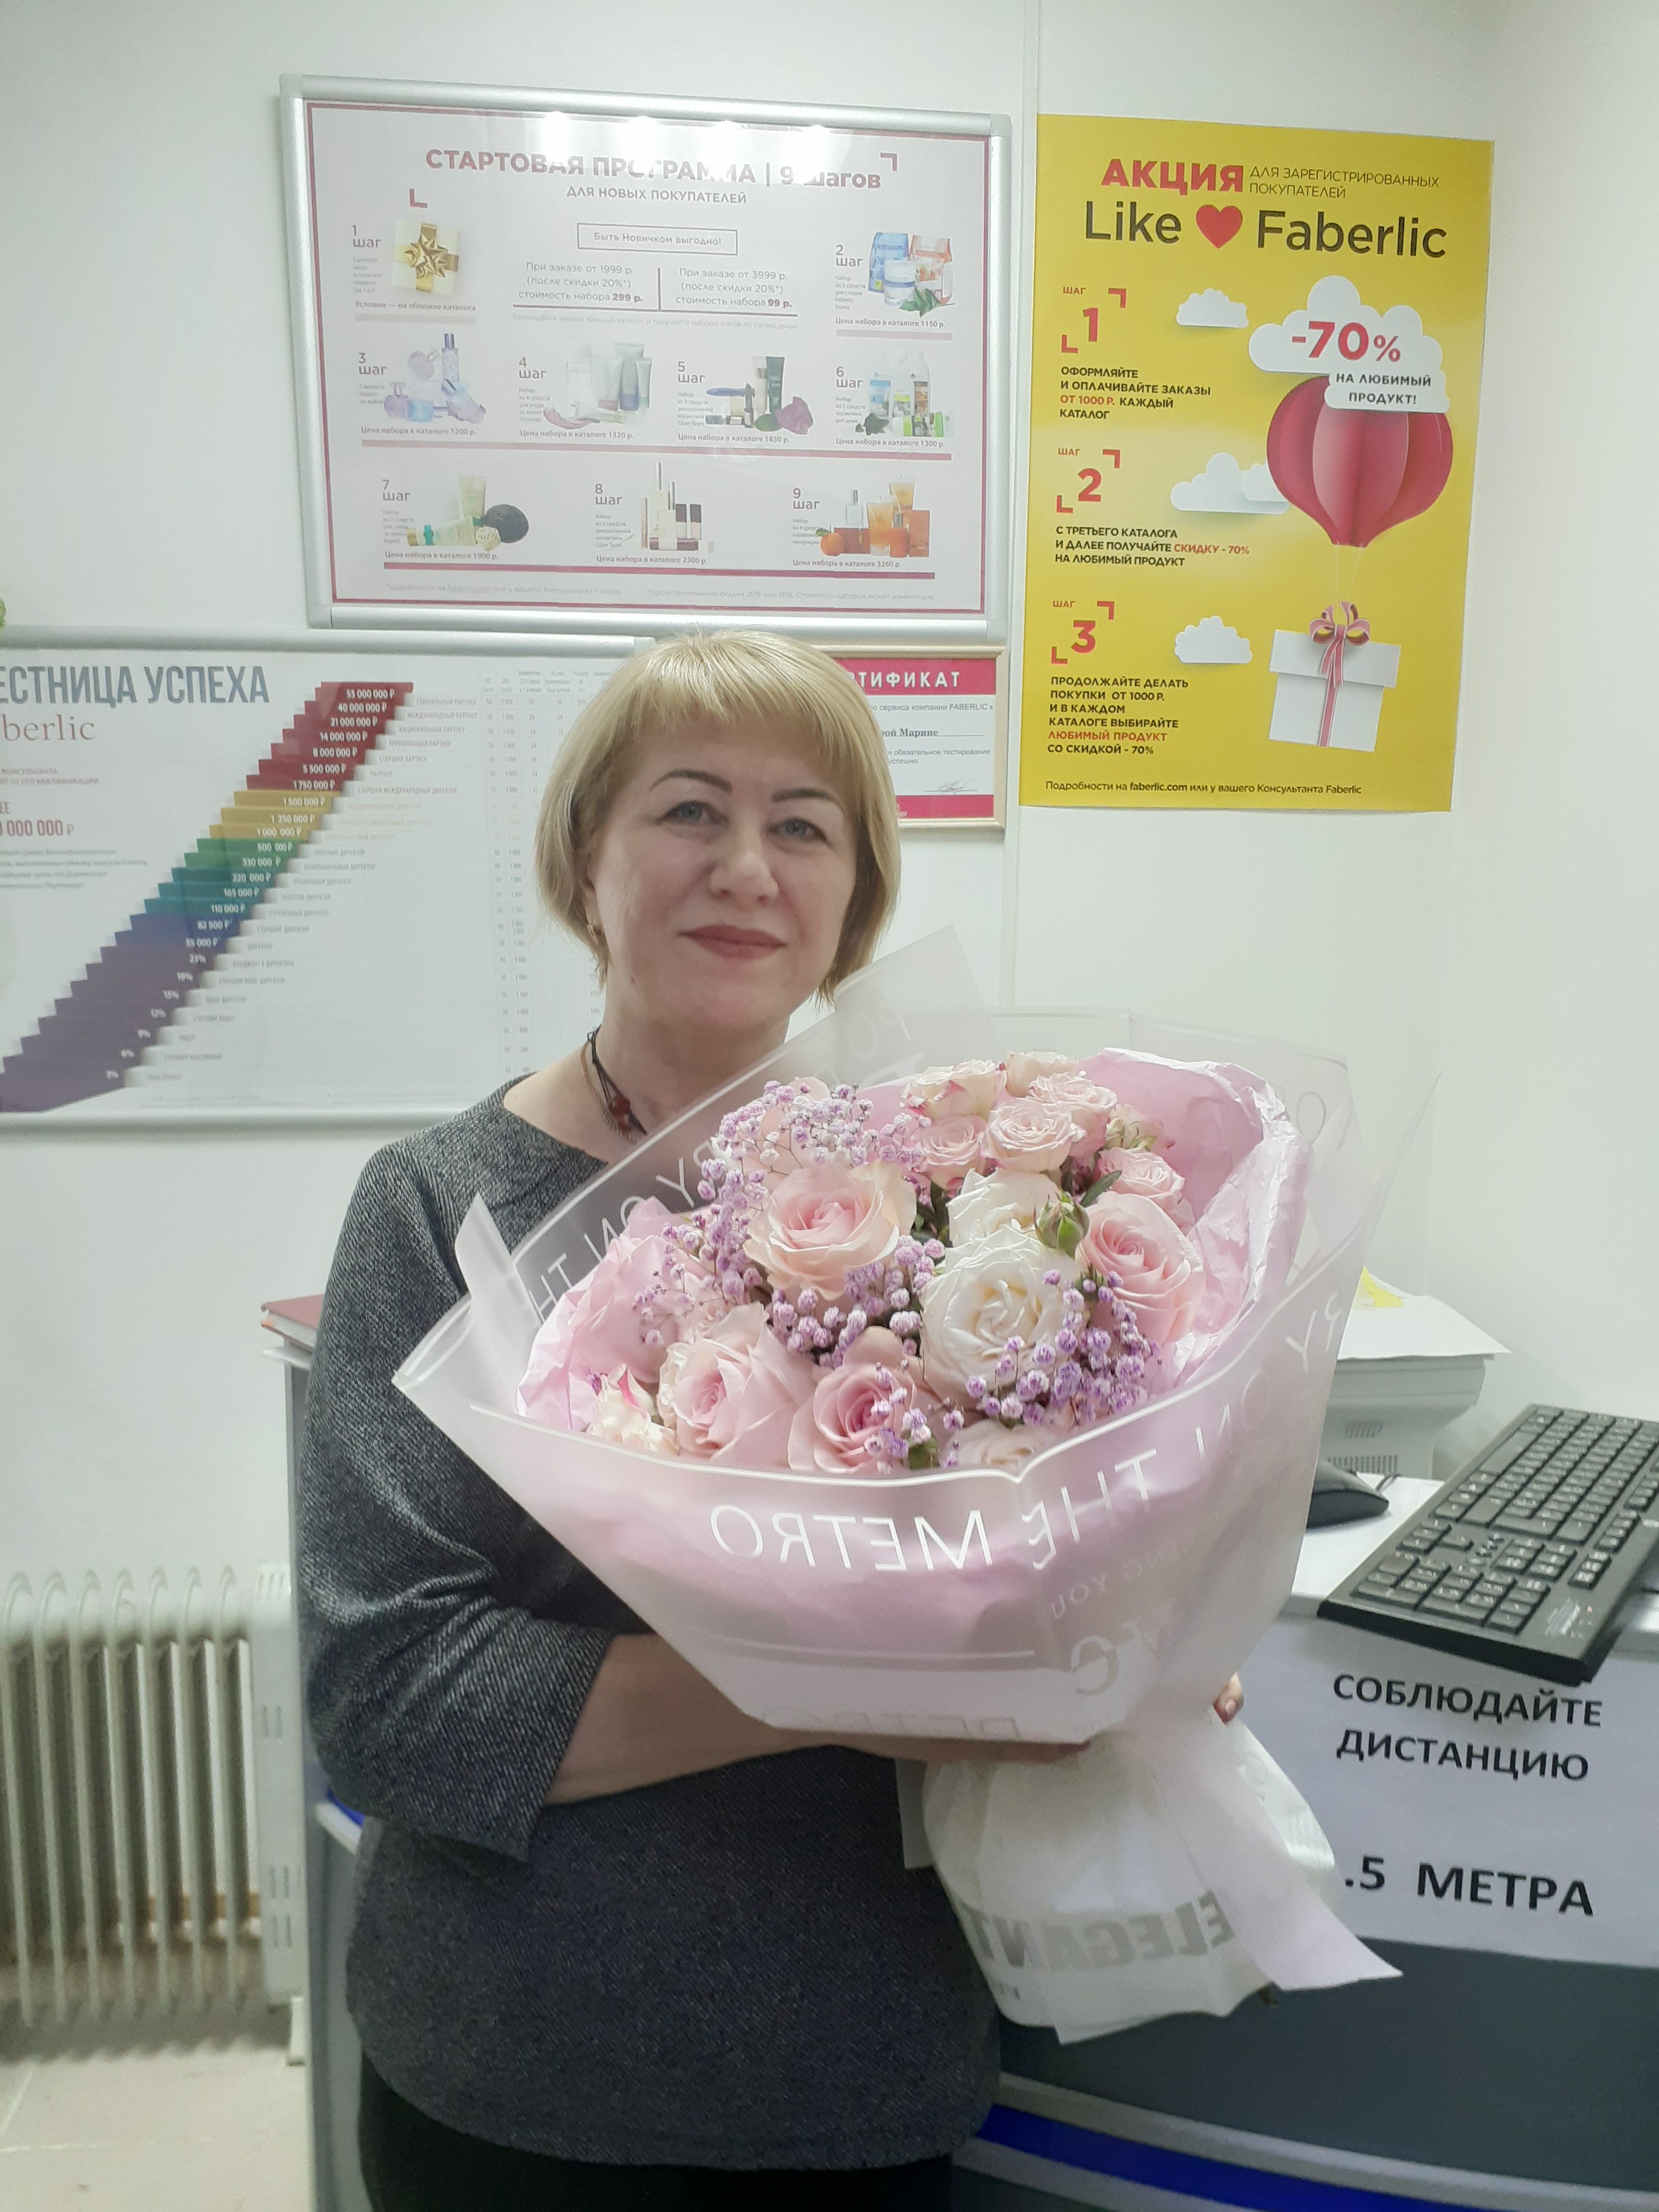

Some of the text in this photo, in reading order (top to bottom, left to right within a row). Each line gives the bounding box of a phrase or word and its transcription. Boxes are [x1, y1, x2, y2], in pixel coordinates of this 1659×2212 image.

[426, 149, 584, 176] СТАРТОВАЯ
[1100, 157, 1245, 195] АКЦИЯ
[1250, 166, 1439, 188] ДЛЯ ЗАРЕГИСТРИРОВАННЫХ
[567, 186, 747, 204] ДЛЯ НОВЫХ ПОКУПАТЕЛЕЙ
[1250, 183, 1345, 199] ПОКУПАТЕЛЕЙ
[352, 225, 357, 236] 1
[1086, 201, 1446, 258] Like Faberlic
[353, 238, 382, 248] шаг
[594, 231, 722, 245] Быть Новичком выгодно!
[836, 245, 843, 256] 2
[526, 261, 547, 272] При
[549, 264, 583, 273] заказе
[585, 266, 597, 274] от
[599, 263, 624, 275] 1999
[836, 257, 863, 267] шаг
[679, 267, 700, 278] При
[702, 270, 736, 279] заказе
[752, 269, 777, 280] 3999
[527, 275, 561, 286] (после
[564, 279, 601, 287] скидки
[681, 281, 714, 292] (после
[717, 284, 753, 293] скидки
[1063, 286, 1086, 295] ШАГ
[518, 291, 571, 300] стоимость
[573, 292, 611, 303] набора
[612, 293, 631, 302] 299
[675, 296, 728, 305] стоимость
[730, 297, 767, 307] набора
[767, 298, 780, 307] 99
[835, 317, 854, 326] Цена
[855, 317, 881, 326] набора
[921, 320, 938, 328] 1150
[1082, 306, 1100, 343] 1
[1292, 320, 1400, 362] -70%
[359, 353, 365, 364] 3
[519, 356, 527, 368] 4
[359, 365, 387, 375] шаг
[678, 361, 685, 372] 5
[836, 366, 844, 377] 6
[1062, 367, 1138, 378] ОФОРМЛЯЙТЕ
[519, 370, 547, 379] шаг
[678, 373, 705, 384] шаг
[1336, 373, 1431, 386] НА ЛЮБИМЫЙ
[837, 378, 863, 388] шаг
[1061, 380, 1210, 395] И ОПЛАЧИВАЙТЕ ЗАКАЗЫ
[1060, 395, 1173, 409] ОТ 1000 Р. КАЖДЫЙ
[1349, 392, 1416, 405] ПРОДУКТ!
[1060, 408, 1110, 419] КАТАЛОГ
[1058, 447, 1080, 455] ШАГ
[383, 479, 390, 490] 7
[595, 483, 602, 494] 8
[1077, 467, 1102, 504] 2
[383, 492, 410, 502] шаг
[793, 488, 801, 499] 9
[596, 496, 623, 505] шаг
[794, 500, 820, 510] шаг
[1056, 526, 1177, 539] С ТРЕТЬЕГО КАТАЛОГА
[1056, 540, 1063, 549] И
[1066, 540, 1104, 551] ДАЛЕЕ
[1107, 541, 1171, 551] ПОЛУЧАЙТЕ
[1174, 544, 1219, 555] СКИДКУ
[1229, 545, 1249, 554] 70%
[793, 558, 811, 566] Цена
[812, 558, 838, 567] набора
[877, 560, 894, 569] 3260
[1056, 554, 1185, 567] НА ЛЮБИМЫЙ ПРОДУКТ
[1070, 619, 1097, 654] 3
[850, 671, 960, 688] ТИФИКАТ
[1051, 676, 1188, 689] ПРОДОЛЖАЙТЕ ДЕЛАТЬ
[0, 664, 270, 708] ЕСТНИЦА УСПЕХА
[1051, 690, 1164, 701] ПОКУПКИ ОТ 1000 Р.
[1050, 704, 1125, 715] И В КАЖДОМ
[2, 714, 96, 741] berlic
[1049, 717, 1178, 728] КАТАЛОГЕ ВЫБИРАЙТЕ
[1048, 730, 1167, 743] ЛЮБИМЫЙ ПРОДУКТ
[1048, 744, 1063, 753] СО
[1066, 743, 1121, 755] СКИДКОЙ
[1132, 746, 1154, 754] 70%
[1046, 781, 1113, 791] Подробности
[1130, 782, 1187, 791] faberlic.com
[1210, 786, 1215, 794] у
[1258, 784, 1323, 794] Консультанта
[1326, 785, 1361, 794] Faberlic
[1333, 1675, 1603, 1731] СОБЛЮДАЙТЕ
[1336, 1730, 1588, 1781] ДИСТАНЦИЮ
[1346, 1856, 1593, 1916] .5 МЕТРА
